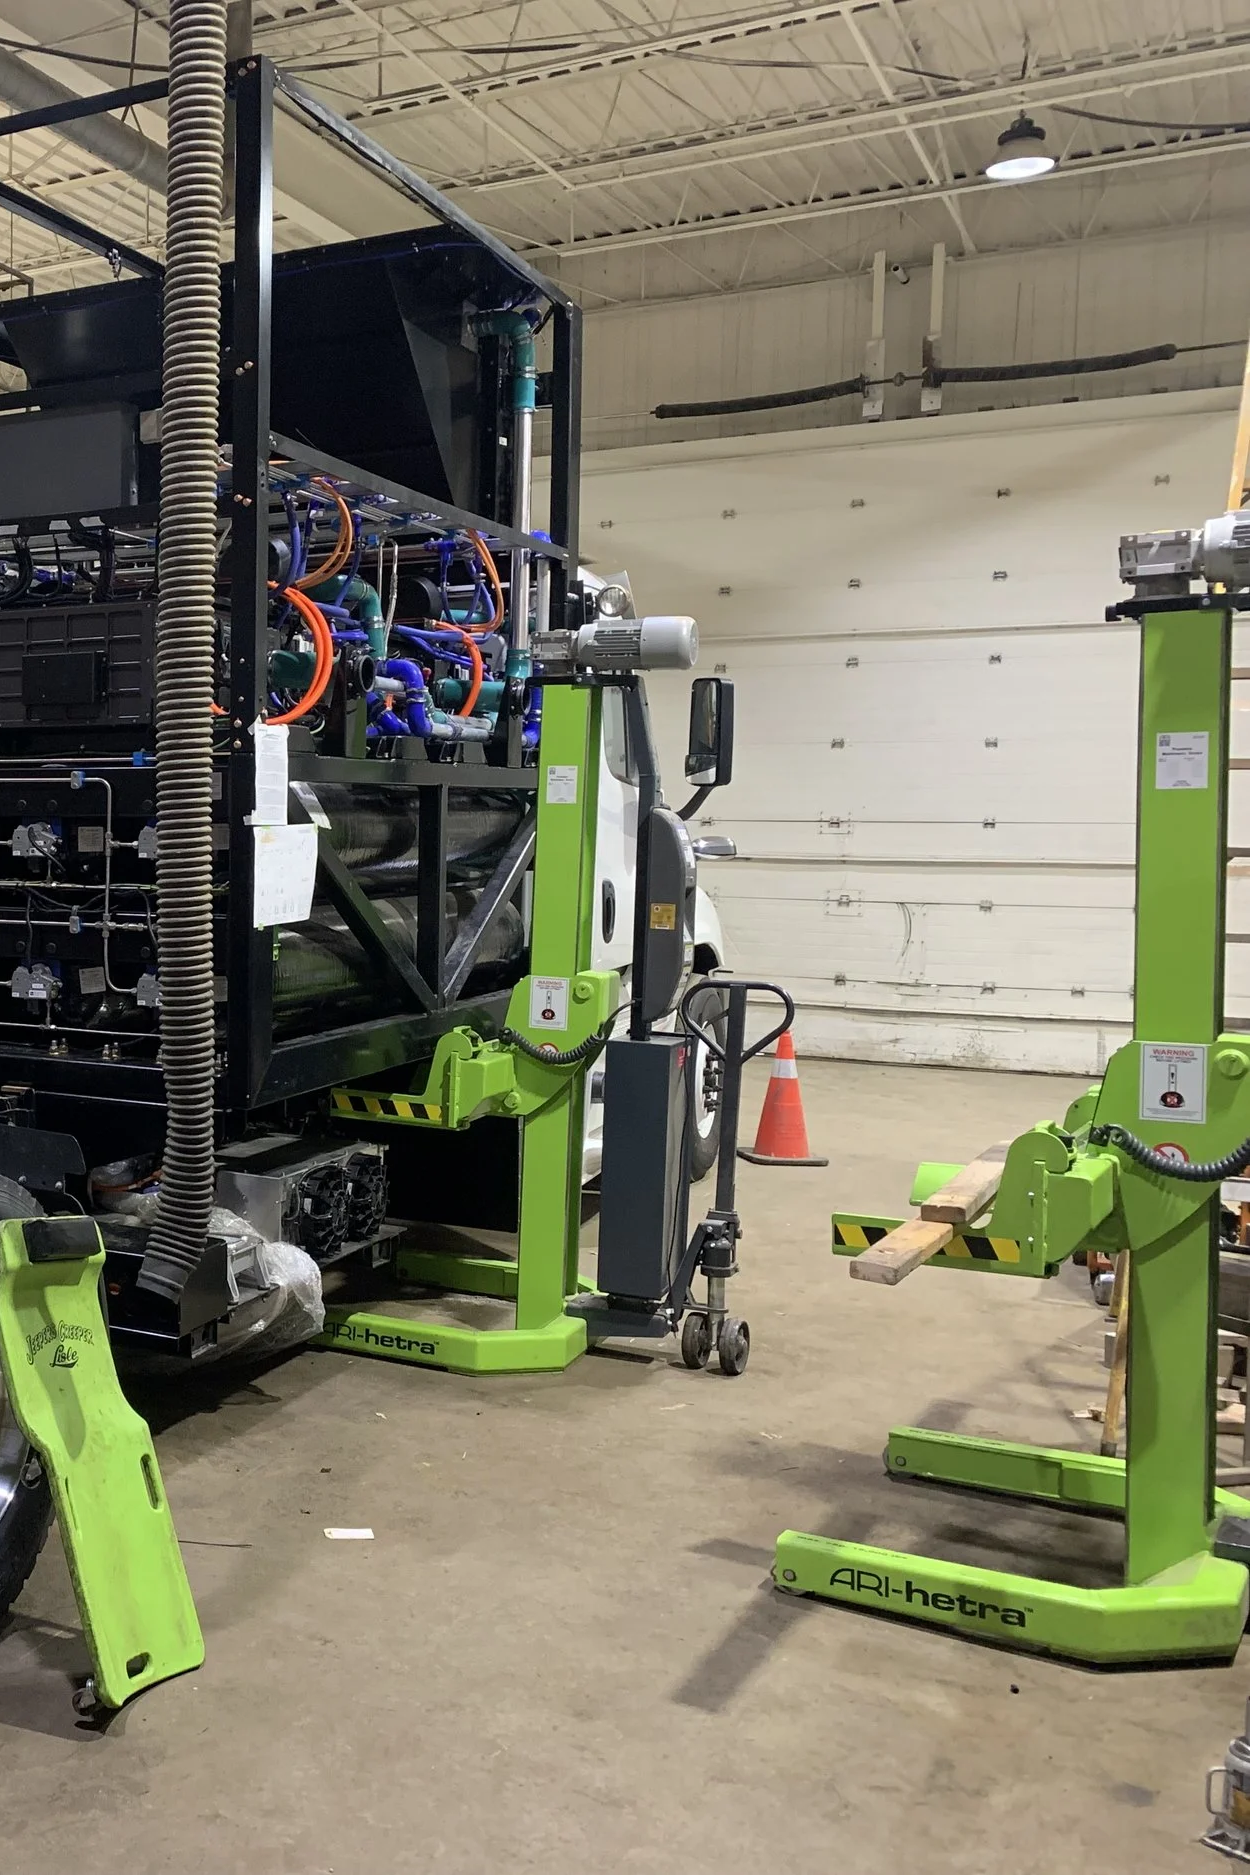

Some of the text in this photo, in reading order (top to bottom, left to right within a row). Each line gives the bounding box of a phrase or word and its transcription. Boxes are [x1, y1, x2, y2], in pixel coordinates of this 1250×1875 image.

[1152, 1048, 1195, 1057] WARNING
[49, 1344, 79, 1368] Lisle
[830, 1567, 1026, 1628] ARI-hetra
